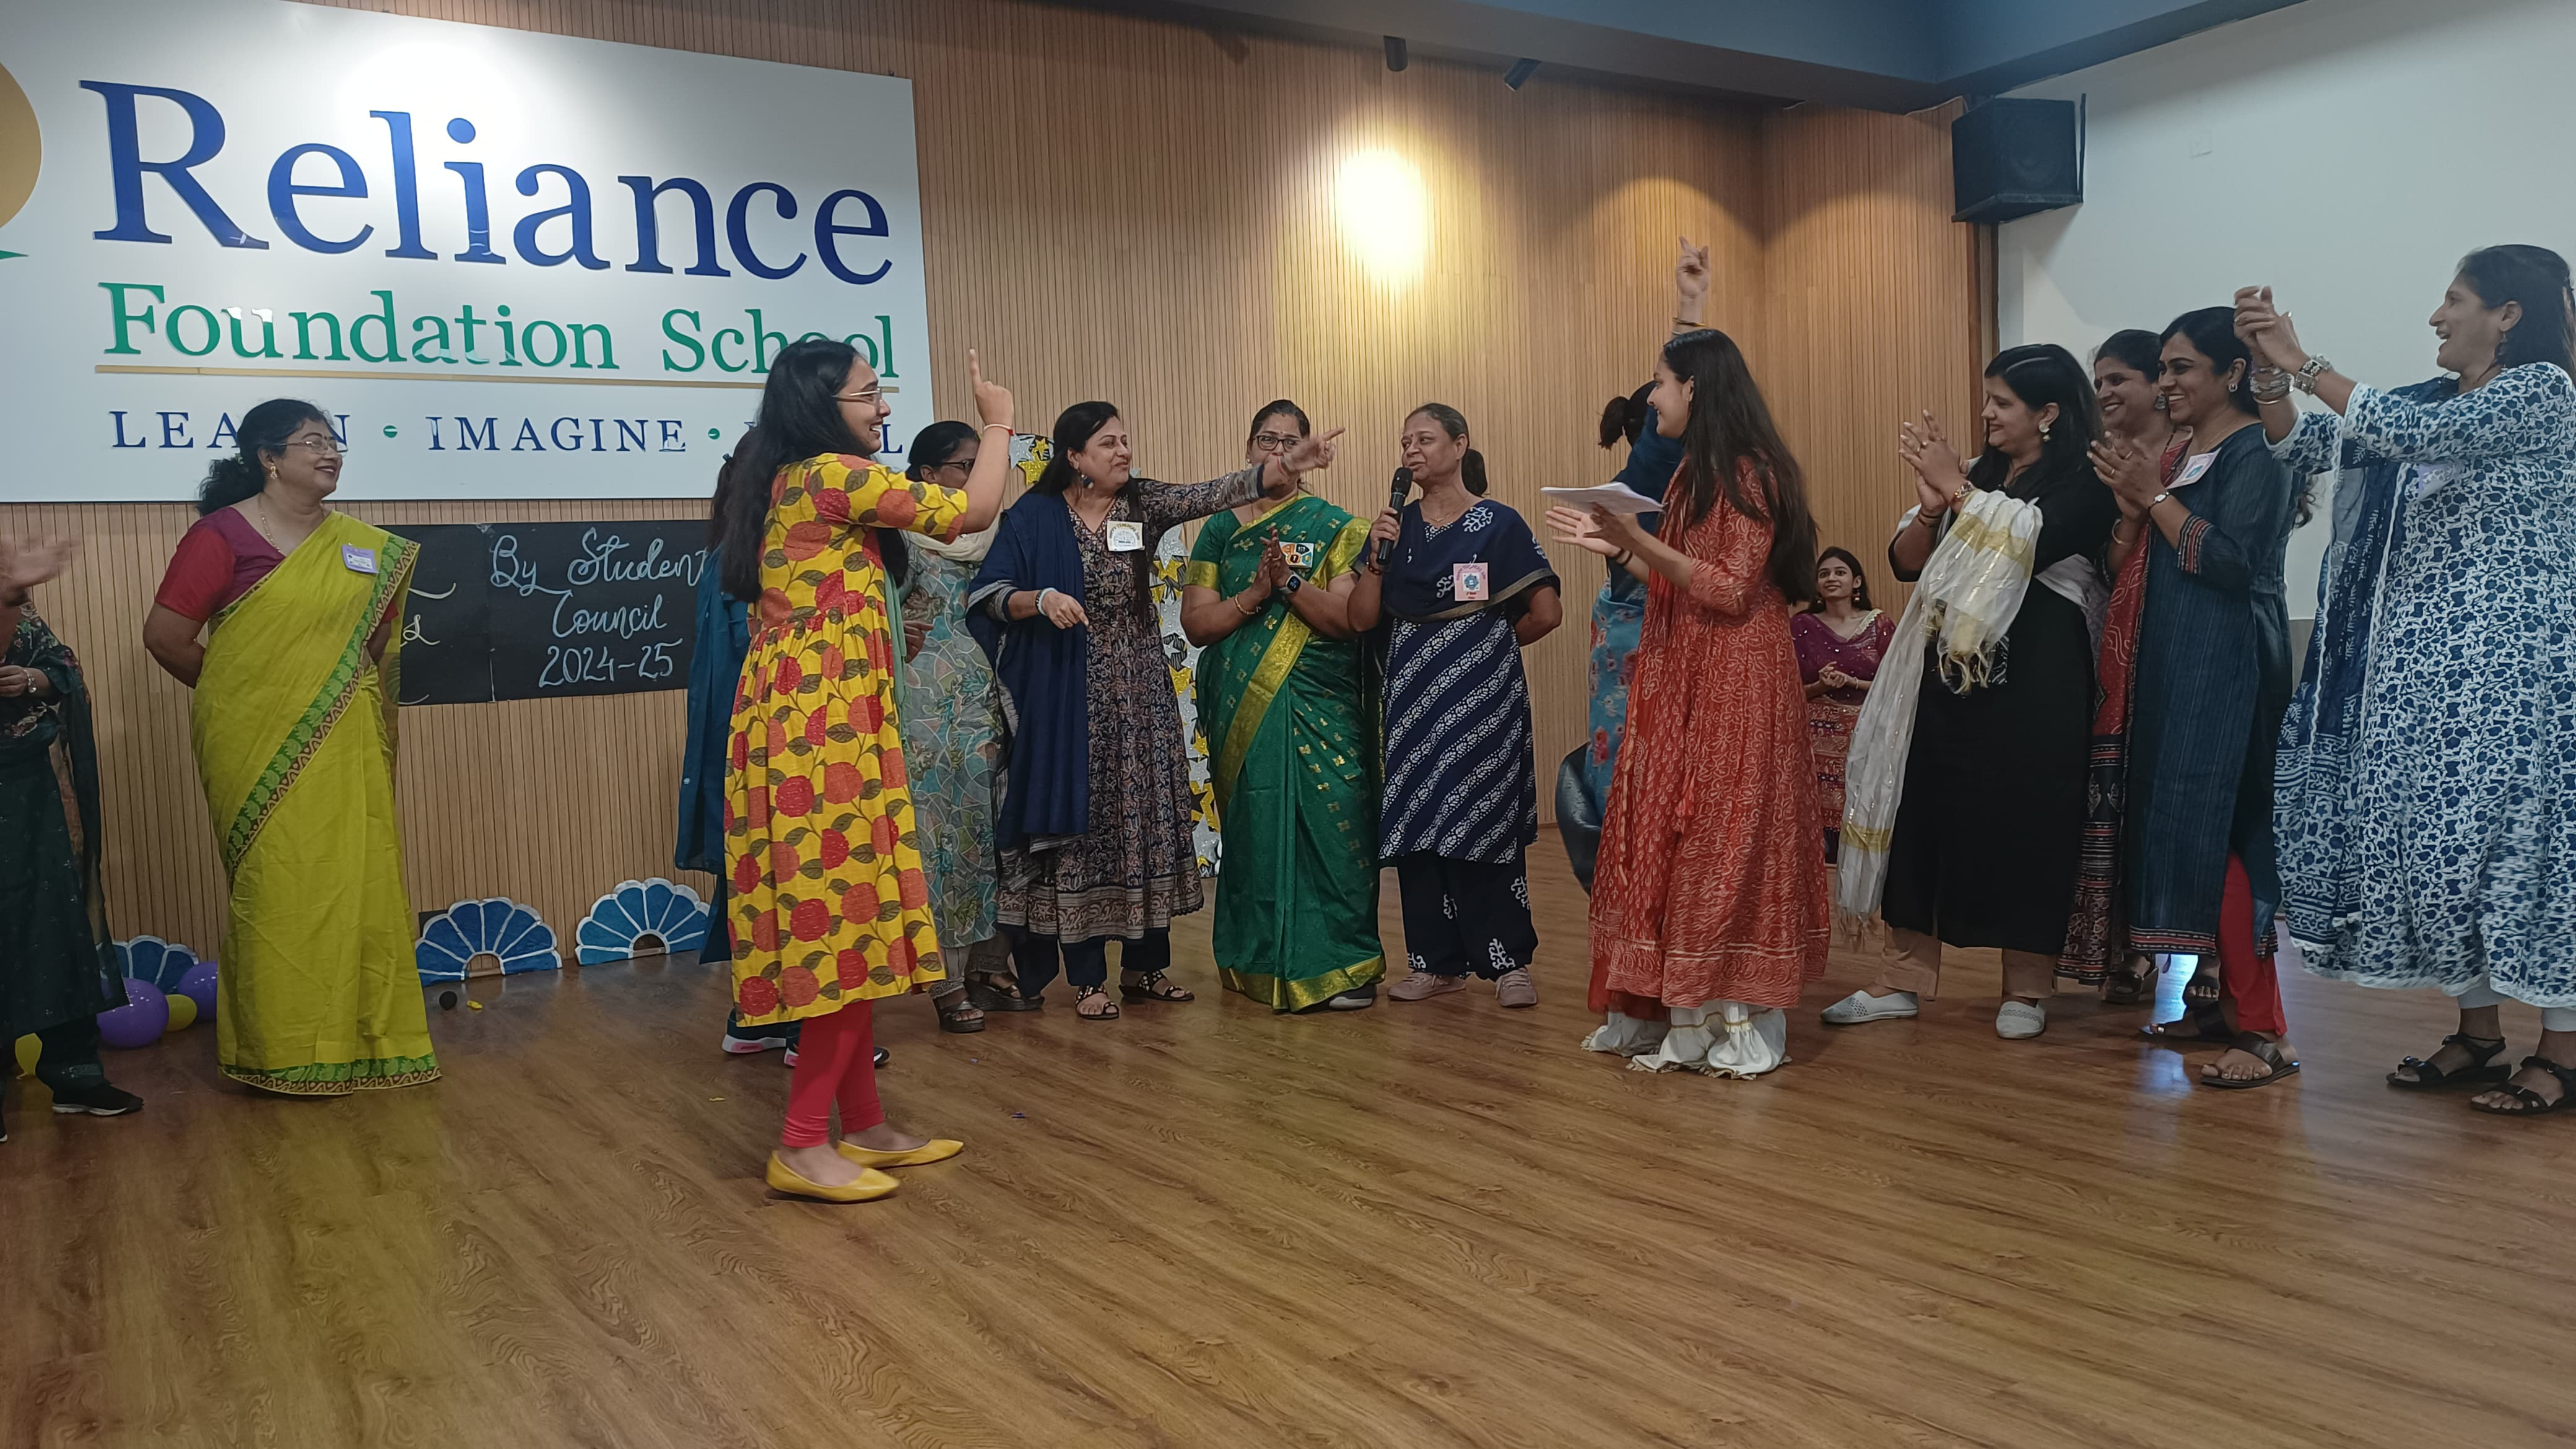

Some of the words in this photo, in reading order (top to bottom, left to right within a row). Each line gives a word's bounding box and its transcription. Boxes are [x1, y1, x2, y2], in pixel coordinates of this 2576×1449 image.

[78, 79, 893, 285] Reliance
[98, 282, 620, 370] Foundation
[661, 308, 899, 378] Schol
[109, 411, 351, 453] LEAN
[425, 416, 686, 453] IMAGINE
[490, 534, 568, 596] By
[552, 593, 667, 639] Council
[539, 638, 683, 688] 2024-25
